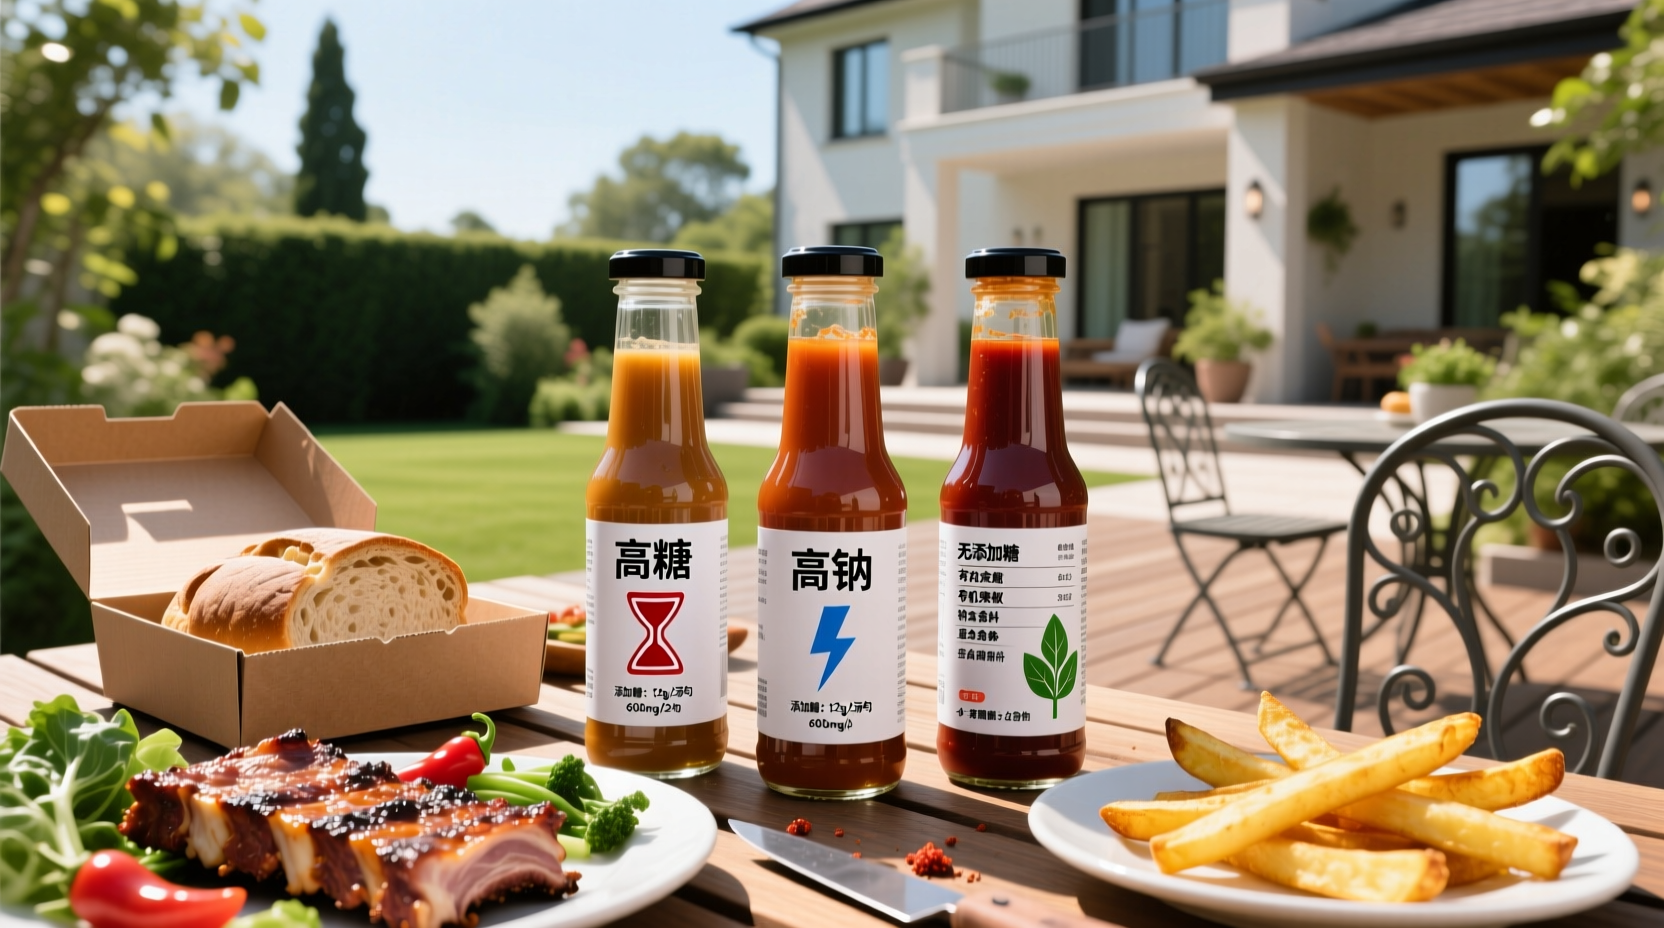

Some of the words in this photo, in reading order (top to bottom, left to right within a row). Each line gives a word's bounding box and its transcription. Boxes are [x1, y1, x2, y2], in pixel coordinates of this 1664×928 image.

[615, 538, 693, 580] 高糖
[791, 548, 872, 592] 高钠
[957, 542, 1020, 563] 无添加糖
